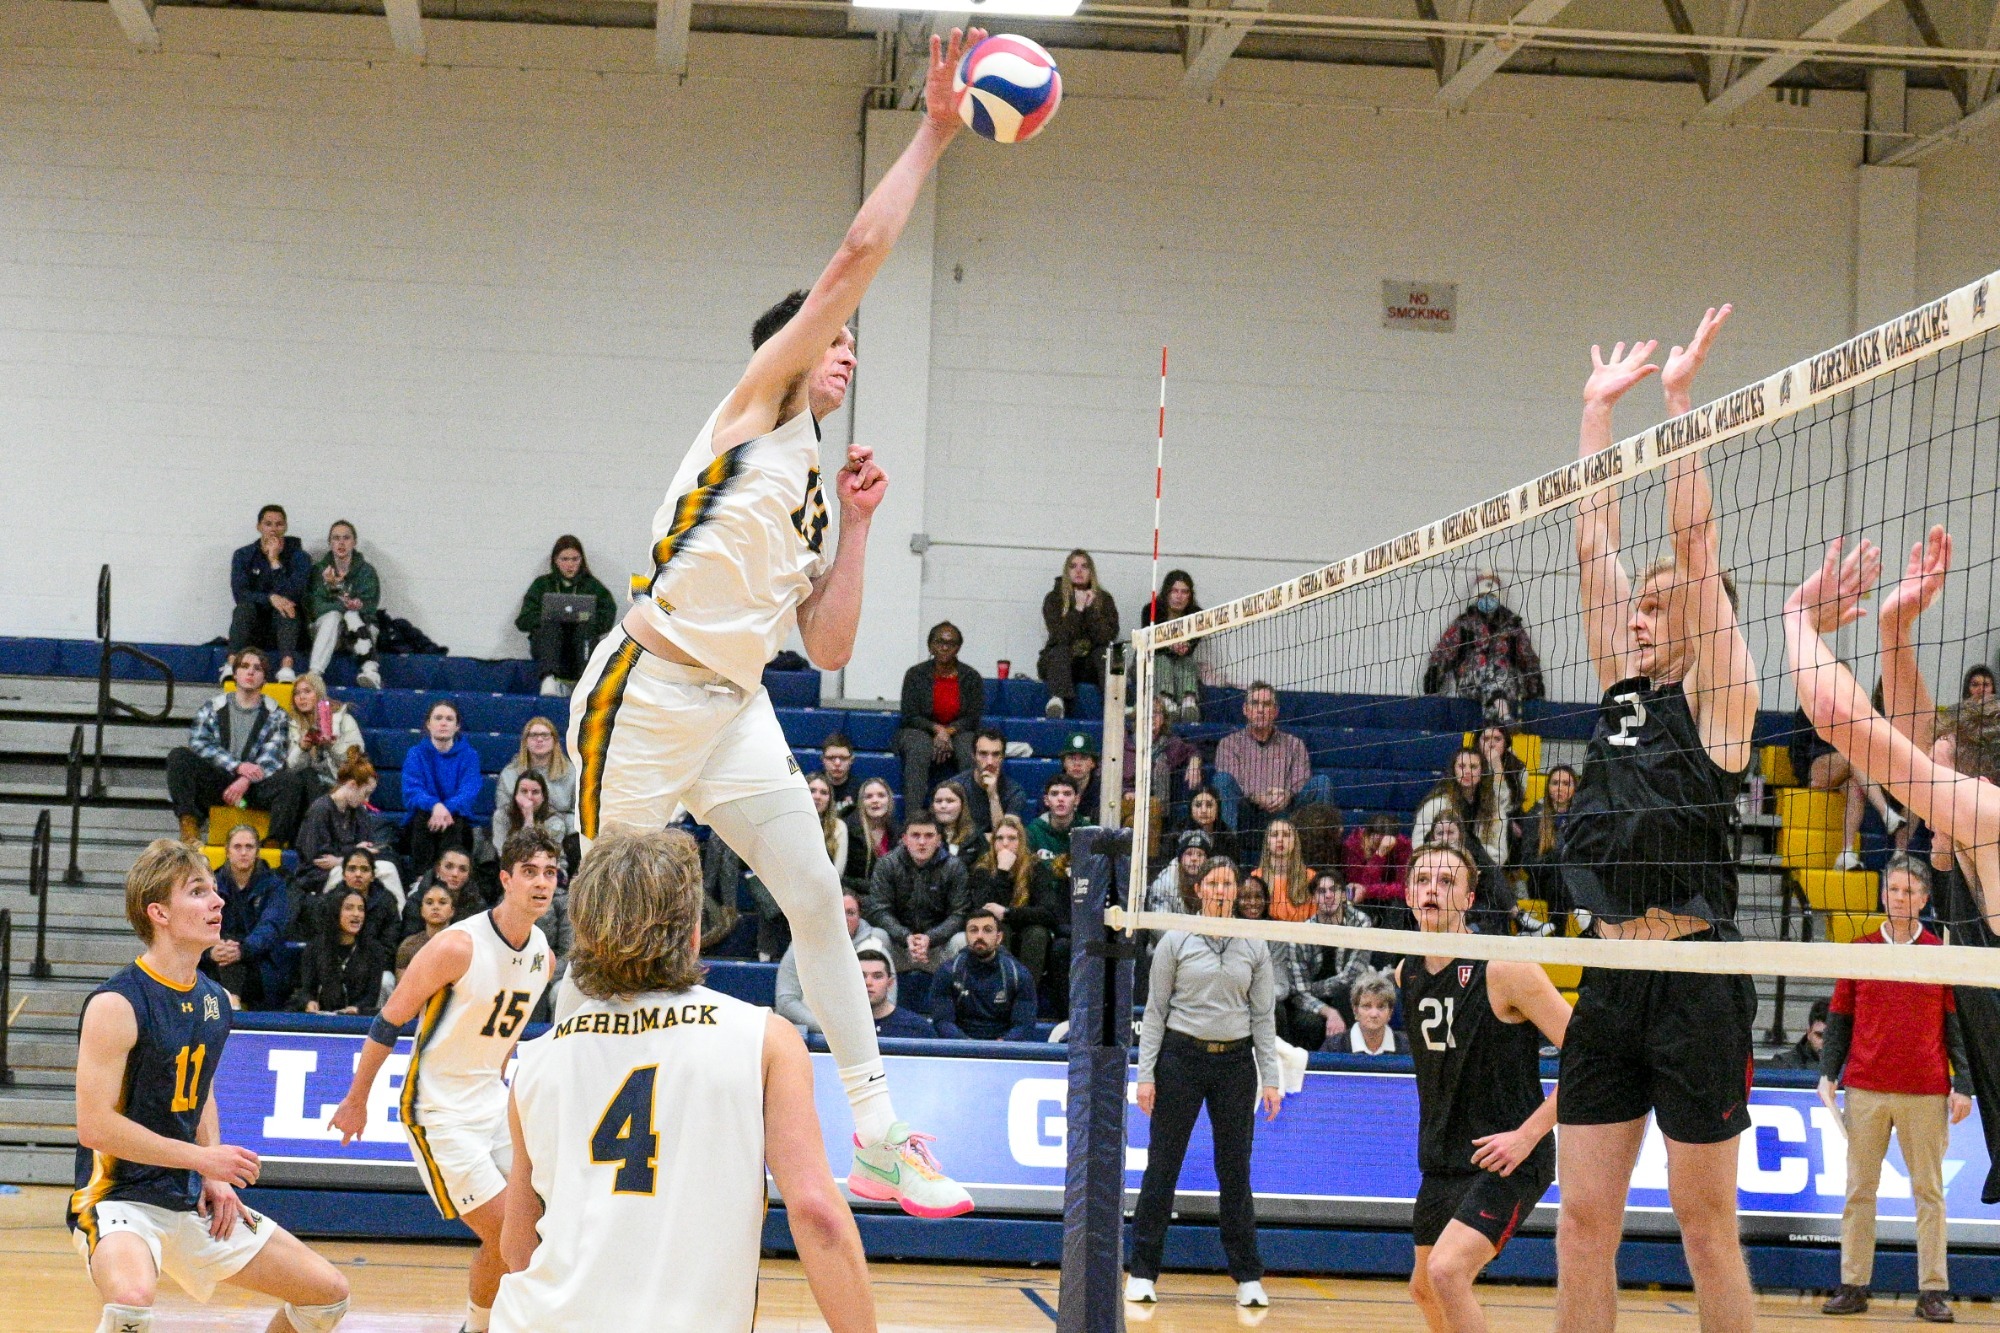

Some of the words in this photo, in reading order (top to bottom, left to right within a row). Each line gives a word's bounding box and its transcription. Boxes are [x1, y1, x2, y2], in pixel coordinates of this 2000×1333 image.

[1388, 306, 1450, 320] SMOKING
[1409, 293, 1429, 305] NO
[1608, 692, 1646, 746] 2
[481, 988, 531, 1038] 15
[553, 1005, 718, 1040] MERRIMACK
[1419, 997, 1456, 1051] 21
[171, 1044, 206, 1112] 11
[589, 1063, 660, 1196] 4
